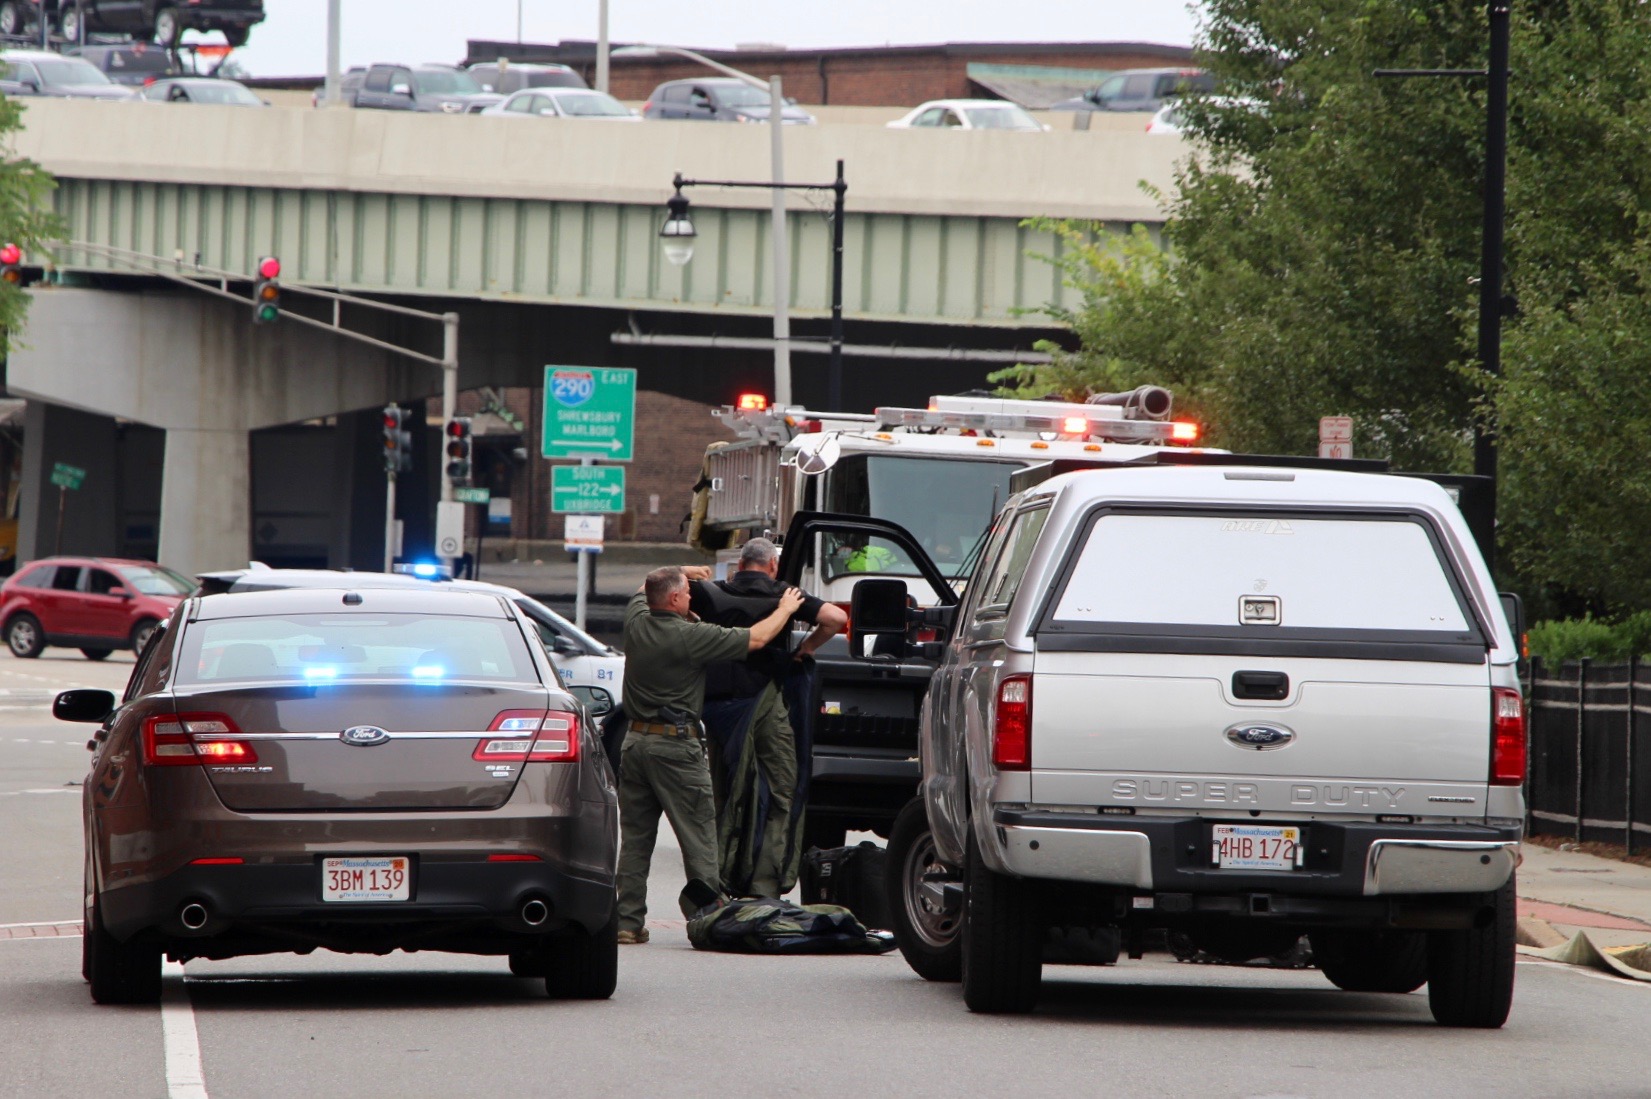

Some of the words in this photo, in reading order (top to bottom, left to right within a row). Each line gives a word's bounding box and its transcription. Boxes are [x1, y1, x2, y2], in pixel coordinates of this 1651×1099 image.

[601, 370, 628, 384] EAST
[555, 379, 590, 397] 290
[557, 410, 621, 423] SHREWSBURY
[563, 424, 616, 437] MARLBORO
[573, 467, 605, 480] SOUTH
[579, 482, 599, 497] 122
[564, 499, 612, 511] UXBRIDGE
[597, 668, 613, 681] 81
[353, 728, 376, 739] Ford
[1246, 728, 1273, 740] Ford
[1112, 779, 1259, 803] SUPER
[1291, 784, 1406, 808] DUTY
[1233, 828, 1281, 836] Massachusetts
[1220, 837, 1252, 859] 4HB
[1259, 838, 1294, 860] 172
[343, 860, 390, 868] Massachusetts
[328, 869, 363, 891] 3BM
[369, 869, 404, 891] 139
